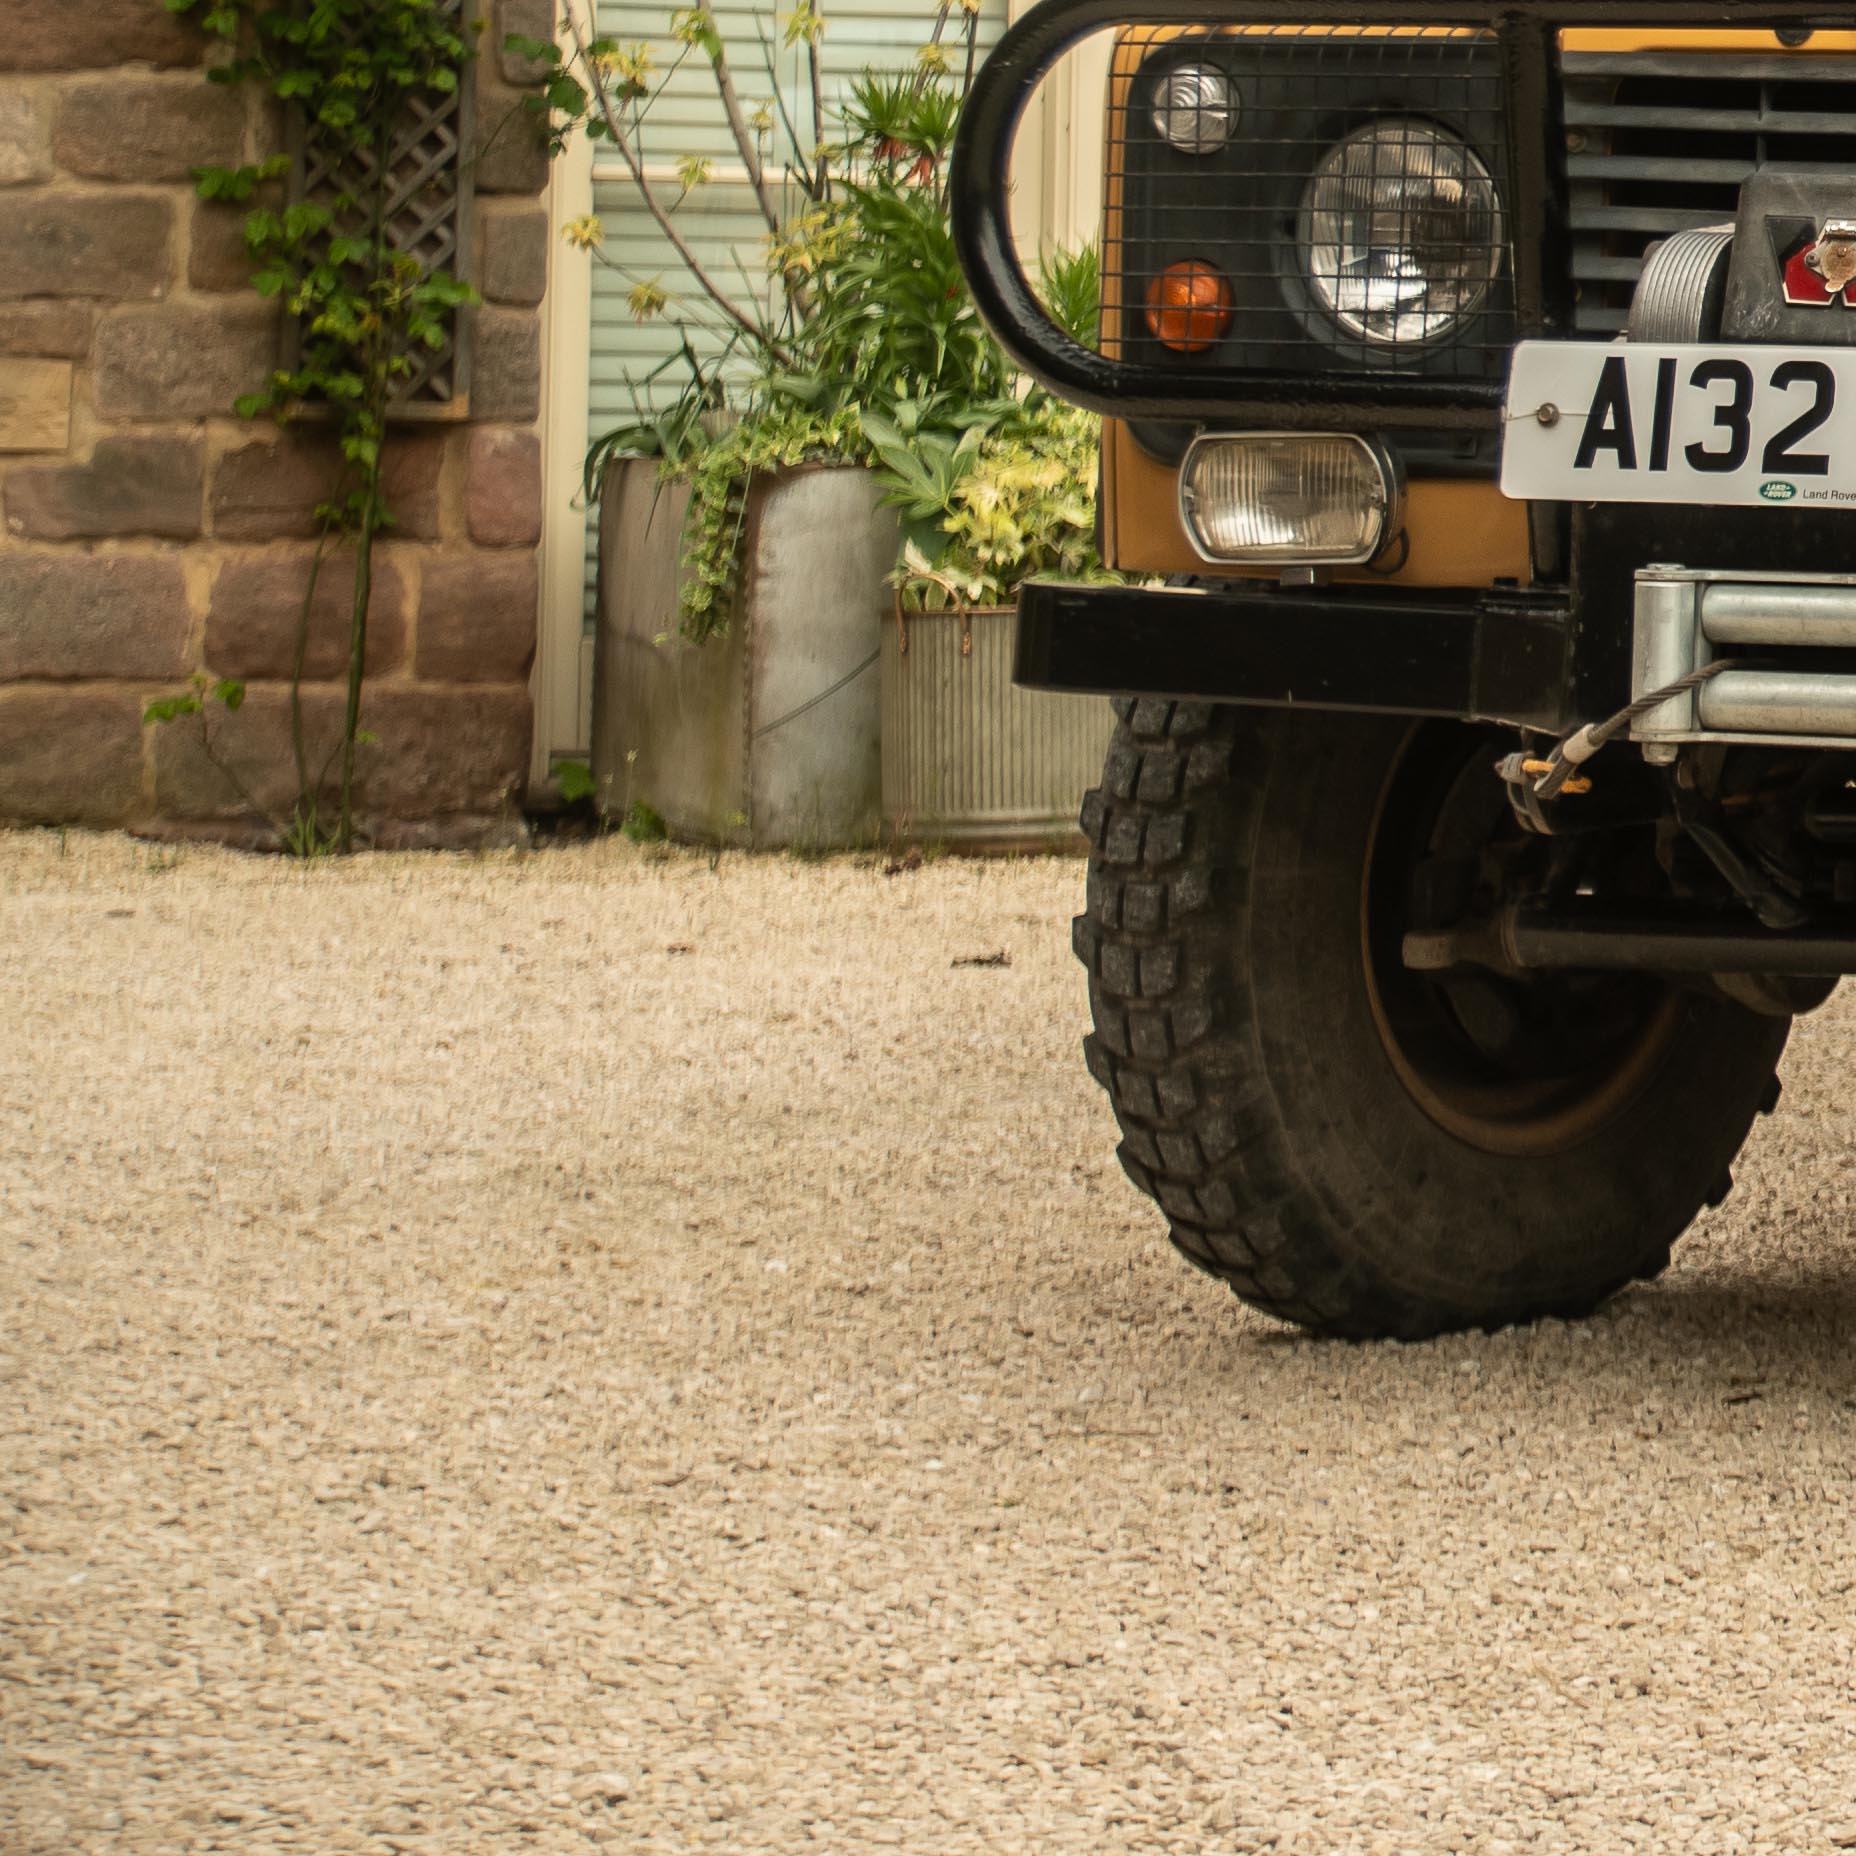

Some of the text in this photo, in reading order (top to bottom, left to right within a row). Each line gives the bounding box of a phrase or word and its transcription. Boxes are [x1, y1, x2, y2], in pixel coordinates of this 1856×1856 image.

[1573, 355, 1837, 476] A132
[1766, 483, 1787, 491] LAND
[1767, 490, 1793, 499] ROVER
[1802, 488, 1828, 500] Land
